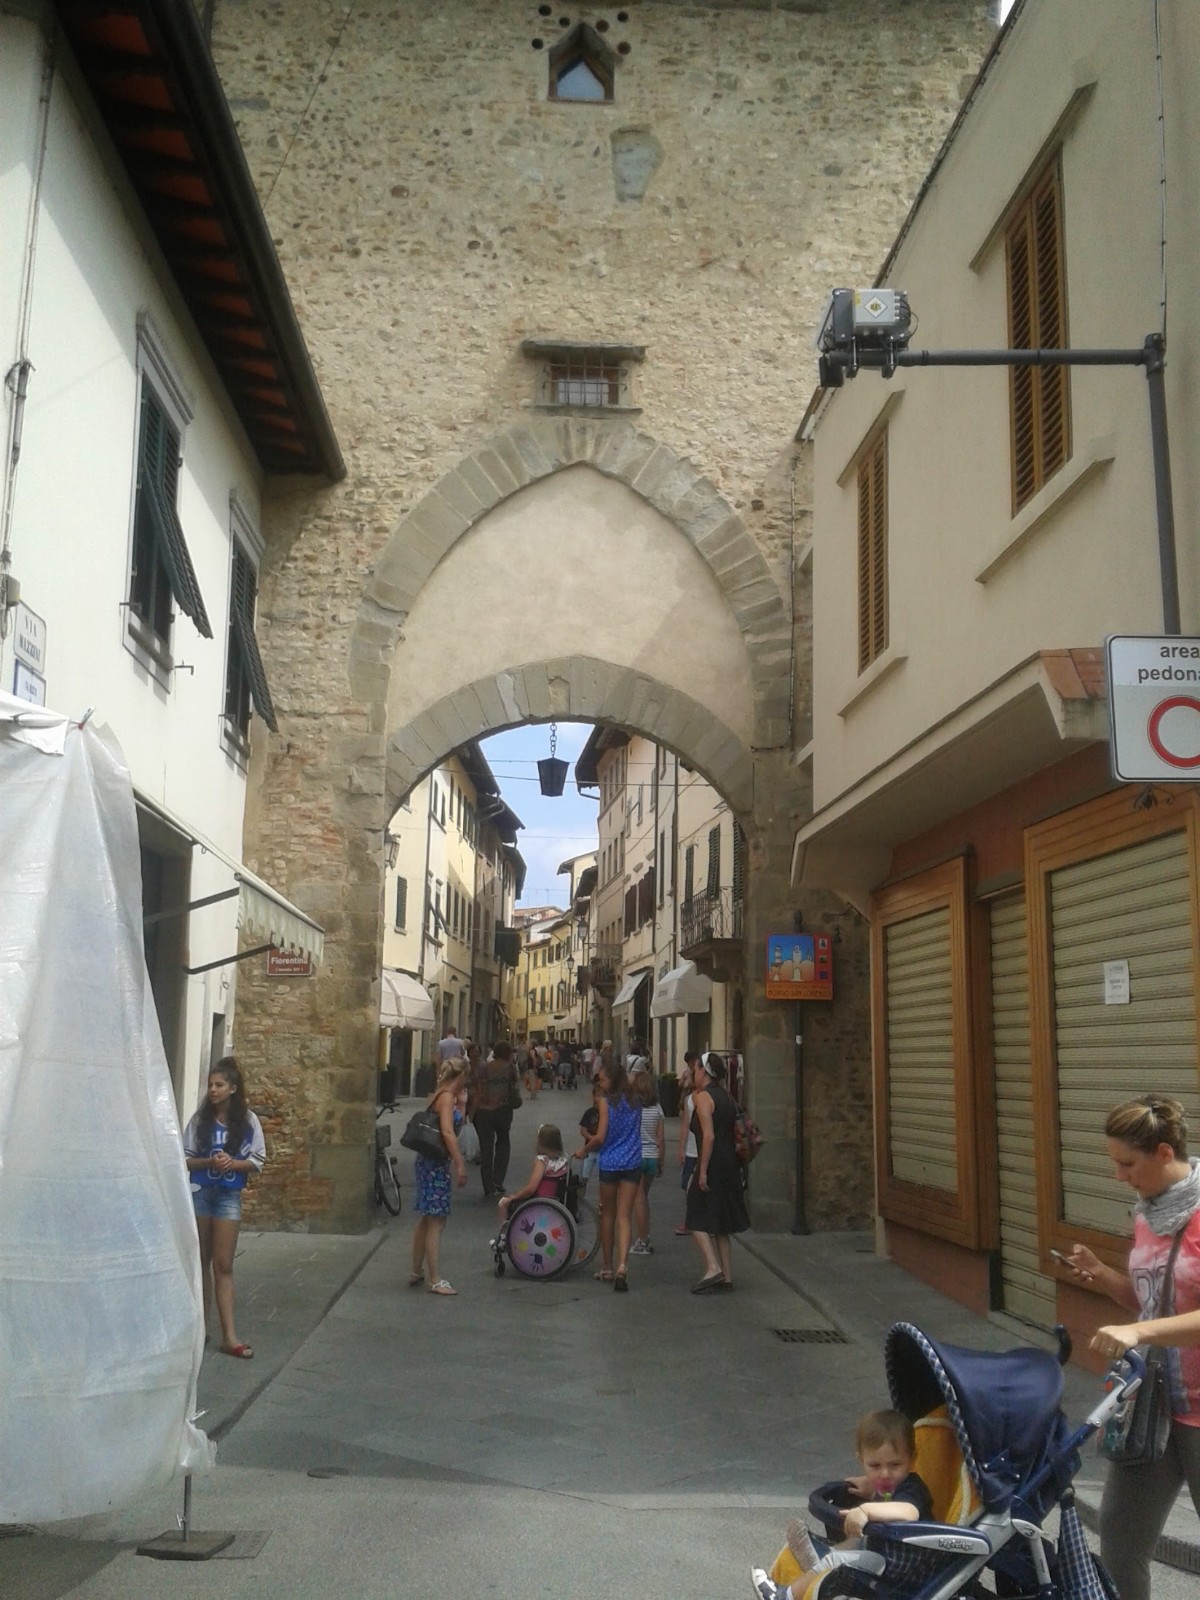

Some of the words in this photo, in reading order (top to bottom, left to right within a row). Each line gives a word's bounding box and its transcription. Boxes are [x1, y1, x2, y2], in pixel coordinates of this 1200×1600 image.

[25, 614, 38, 637] VIA
[19, 633, 41, 663] MAZZINI
[1160, 646, 1200, 658] area
[1138, 666, 1200, 684] pedon
